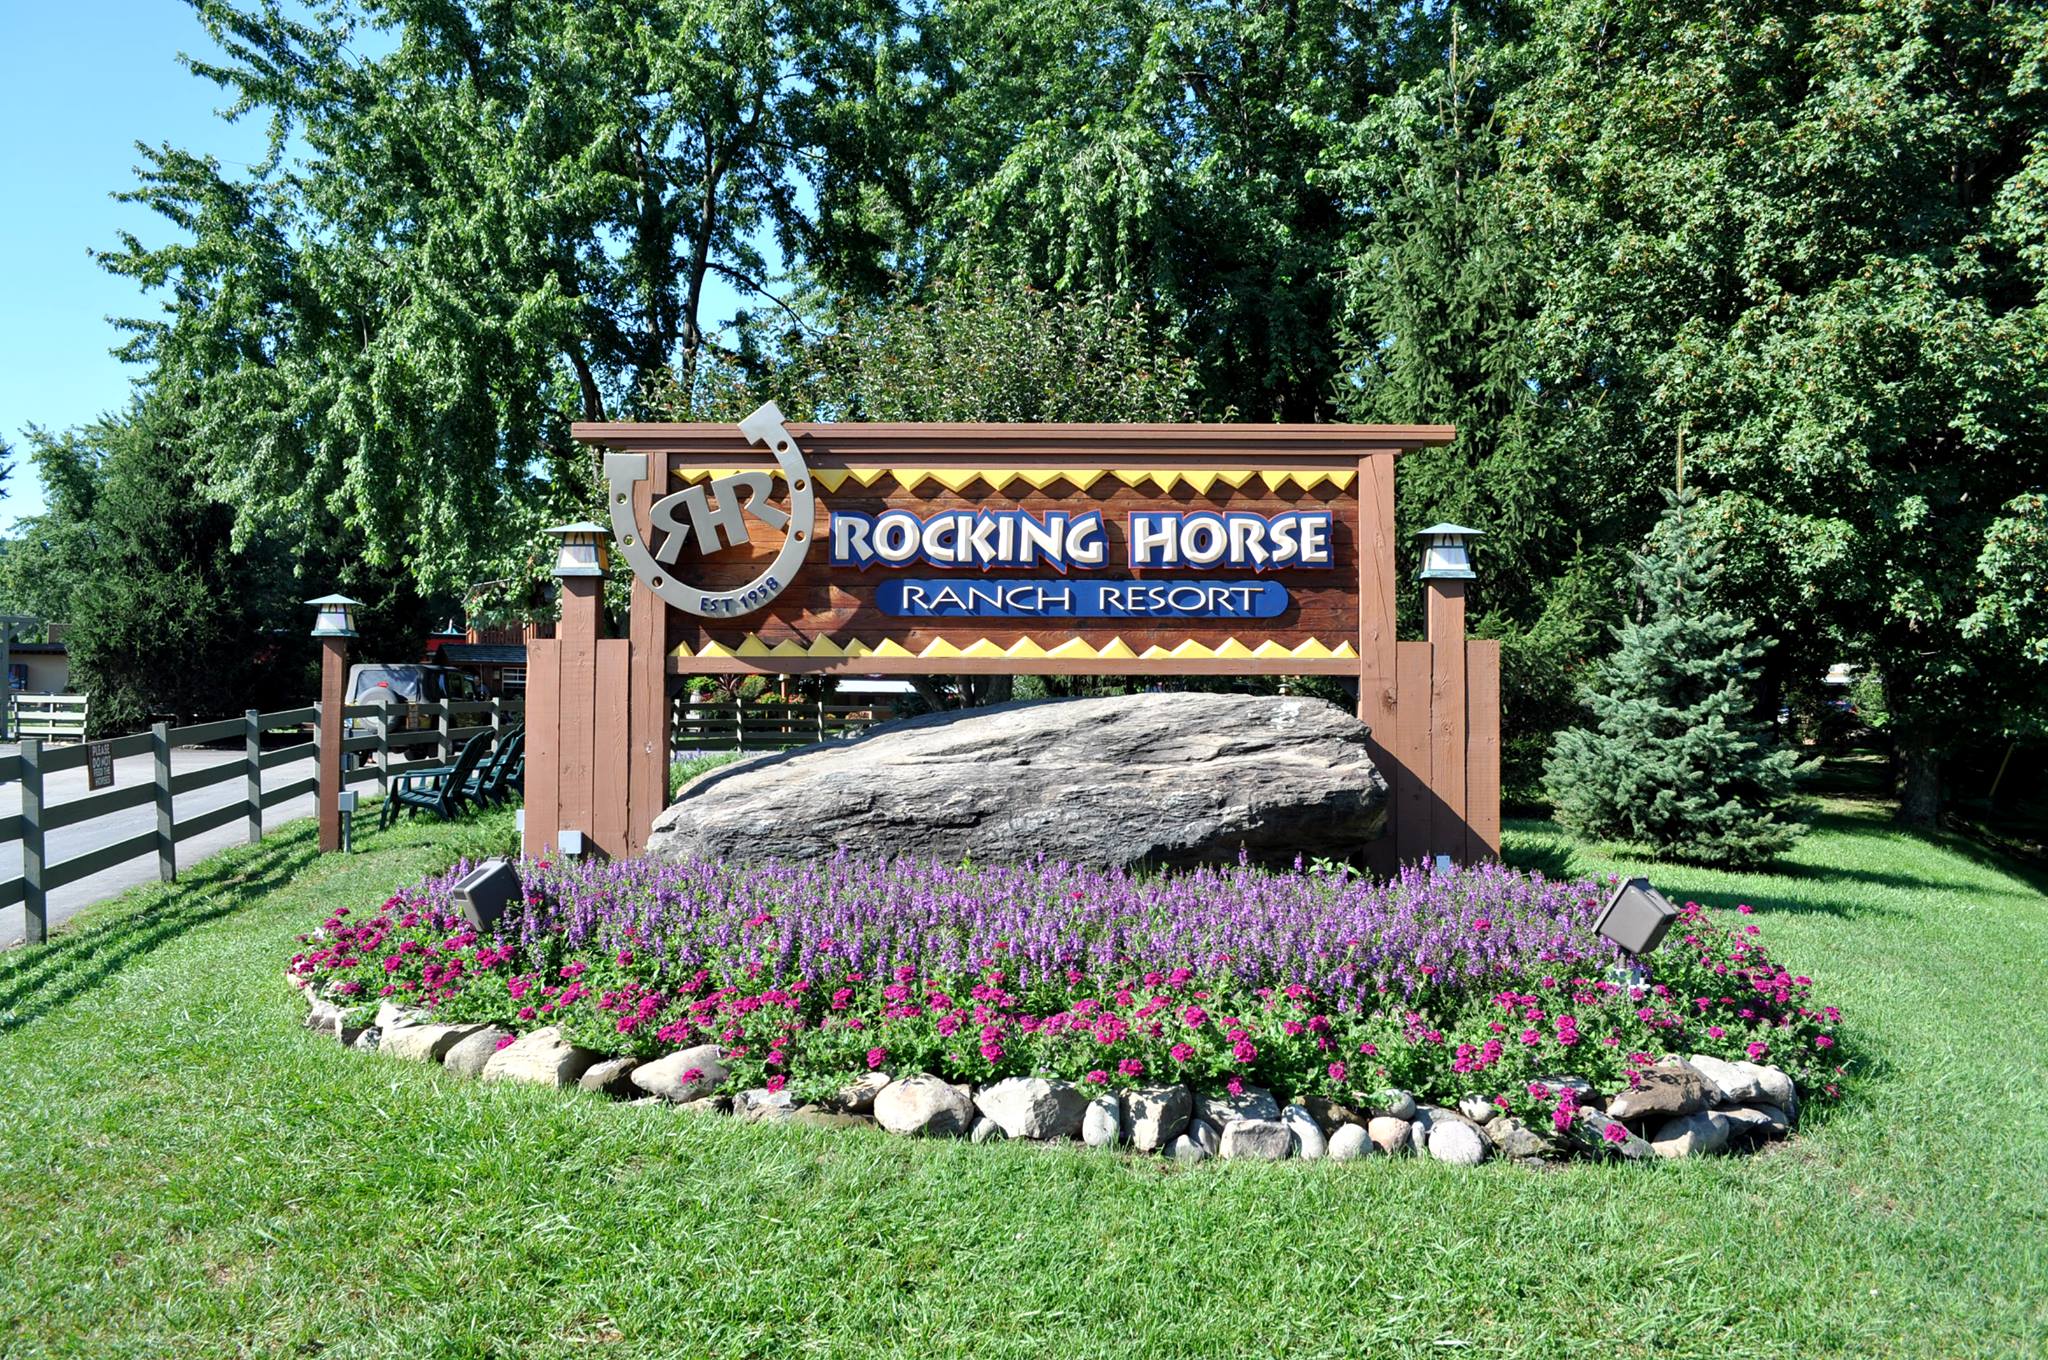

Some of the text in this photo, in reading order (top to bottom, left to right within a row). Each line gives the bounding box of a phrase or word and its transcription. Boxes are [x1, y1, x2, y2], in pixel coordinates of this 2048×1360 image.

[835, 513, 1331, 566] ROCKING HORSE
[700, 576, 779, 612] EST 1958
[902, 585, 1265, 612] RANCH RESORT
[92, 744, 110, 756] PLEASE
[92, 755, 111, 768] DO NOT
